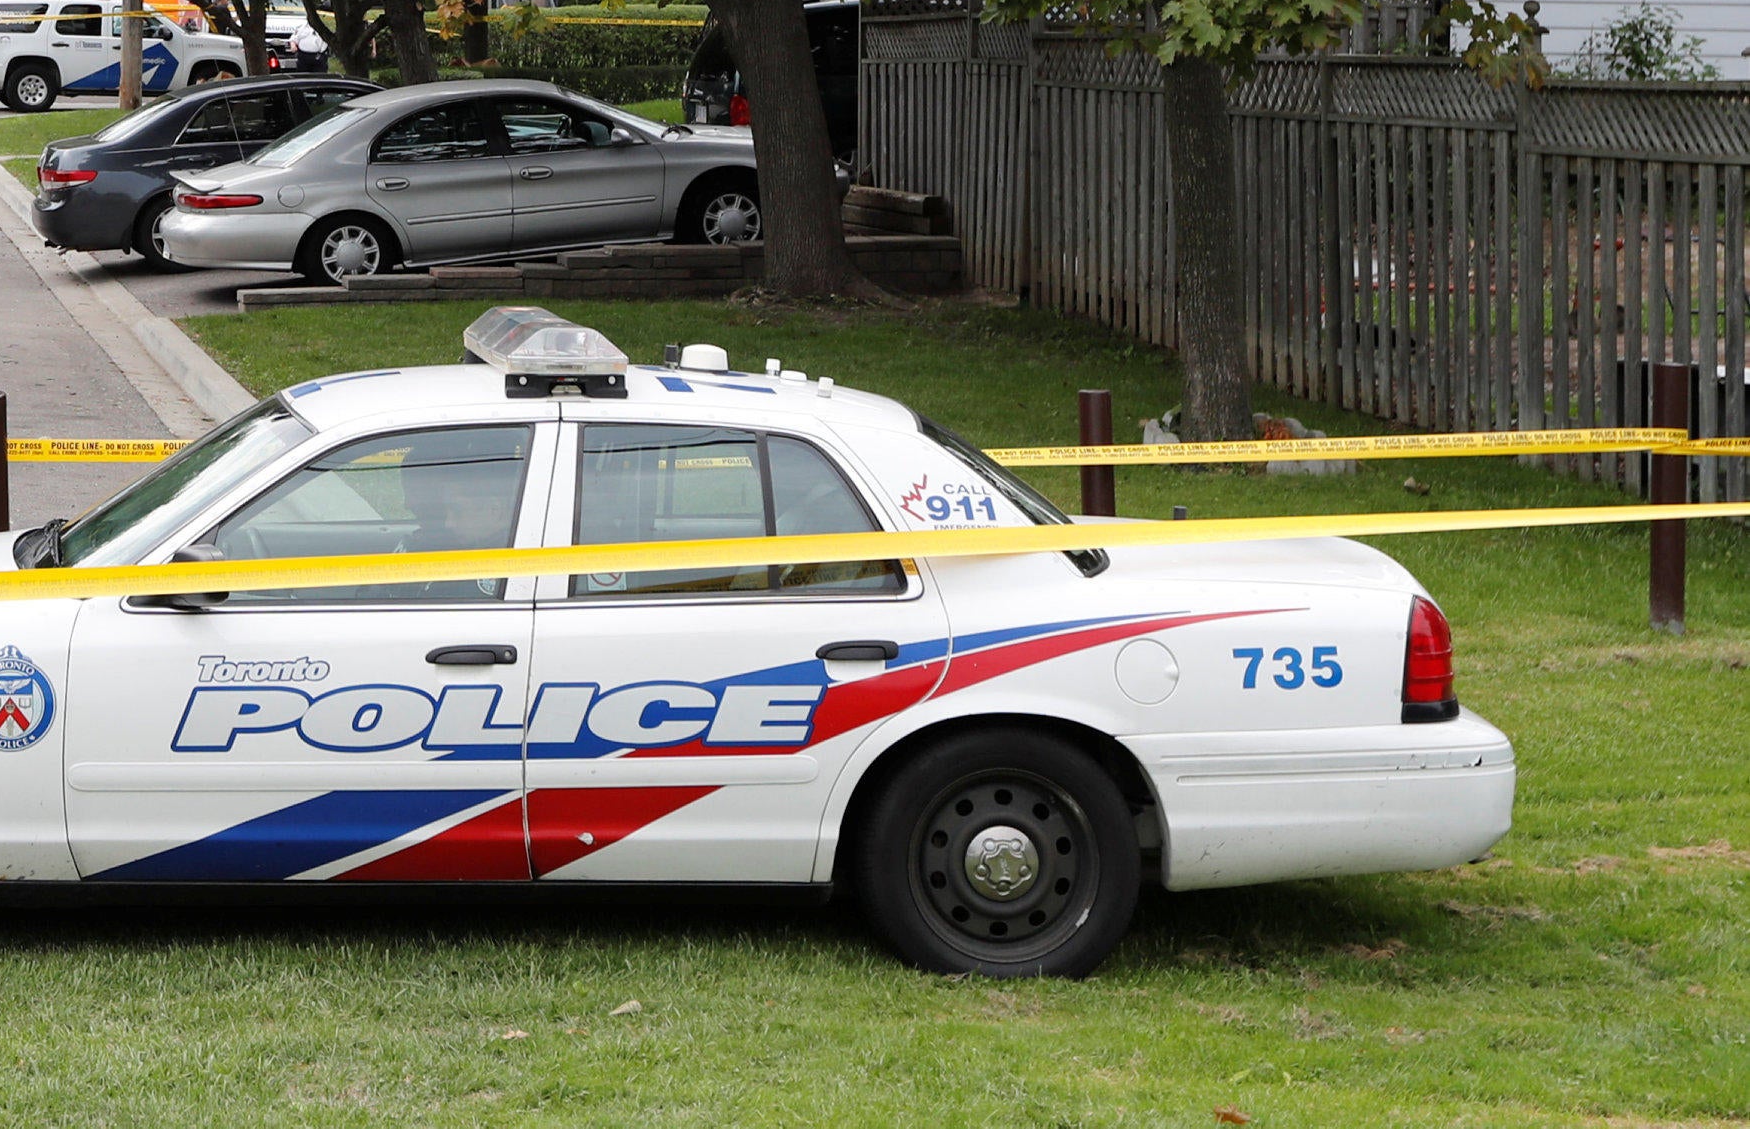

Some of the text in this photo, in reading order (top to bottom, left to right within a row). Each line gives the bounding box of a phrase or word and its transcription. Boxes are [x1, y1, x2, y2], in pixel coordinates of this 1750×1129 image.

[51, 442, 79, 450] POLICE
[943, 484, 991, 495] CALL
[926, 495, 997, 521] 9-1-1
[198, 655, 330, 683] Toronto
[1232, 645, 1345, 690] 735
[171, 680, 829, 754] POLICE
